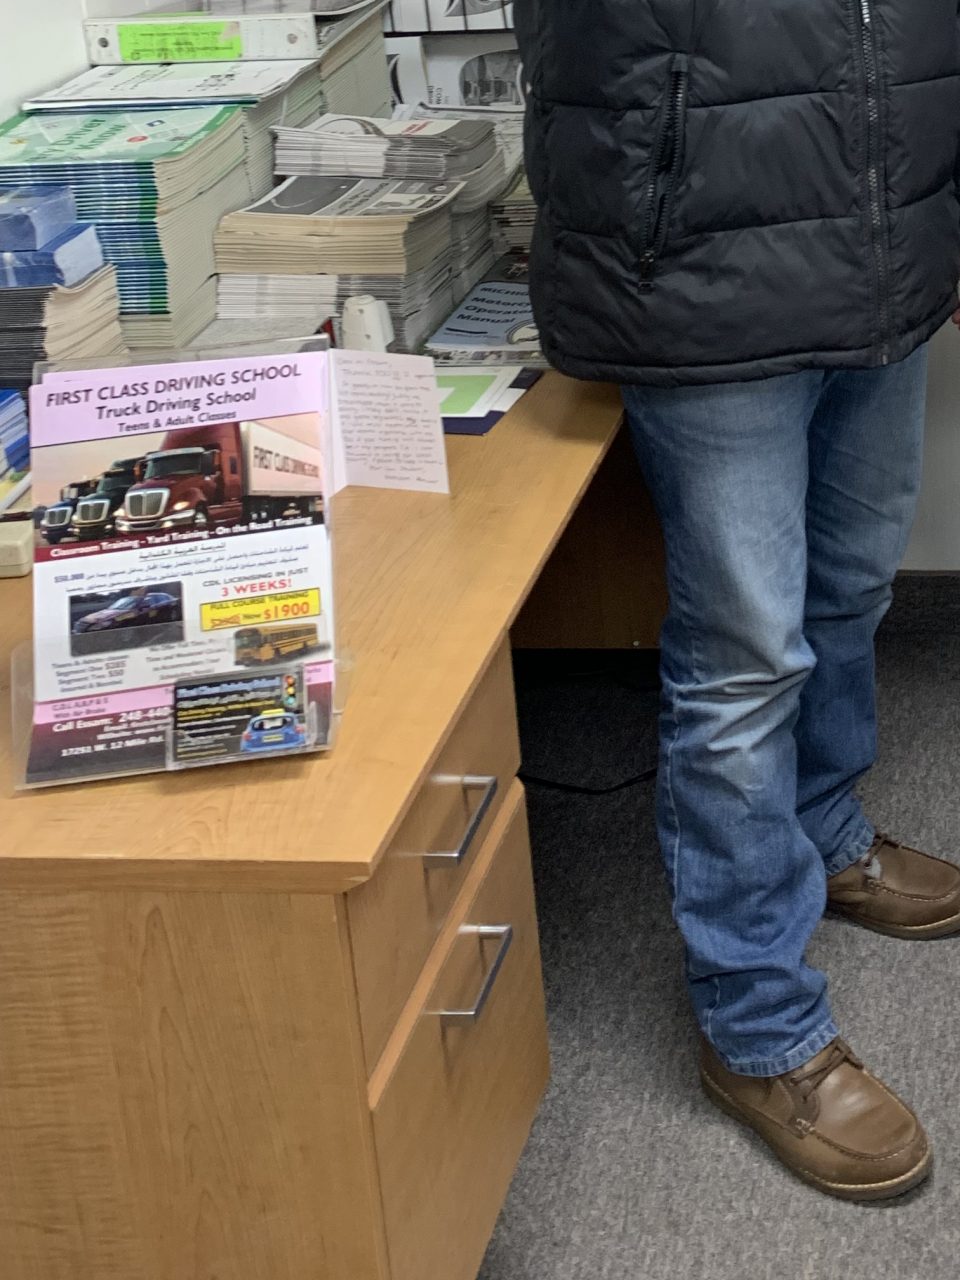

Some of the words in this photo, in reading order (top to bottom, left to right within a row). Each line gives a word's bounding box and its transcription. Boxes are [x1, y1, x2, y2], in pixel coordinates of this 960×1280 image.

[480, 286, 529, 297] MICHIG
[471, 296, 532, 308] Motorc
[456, 313, 516, 324] Manual
[46, 387, 93, 407] FIRST
[97, 381, 149, 401] CLASS
[154, 371, 226, 394] DRIVING
[230, 363, 302, 384] SCHOOL
[96, 399, 141, 420] Truck
[146, 392, 201, 413] Driving
[206, 387, 256, 405] School
[117, 419, 149, 433] Teens
[164, 413, 194, 426] Adult
[221, 587, 229, 597] 3
[233, 579, 293, 595] WEEKS!
[264, 602, 310, 621] $1900
